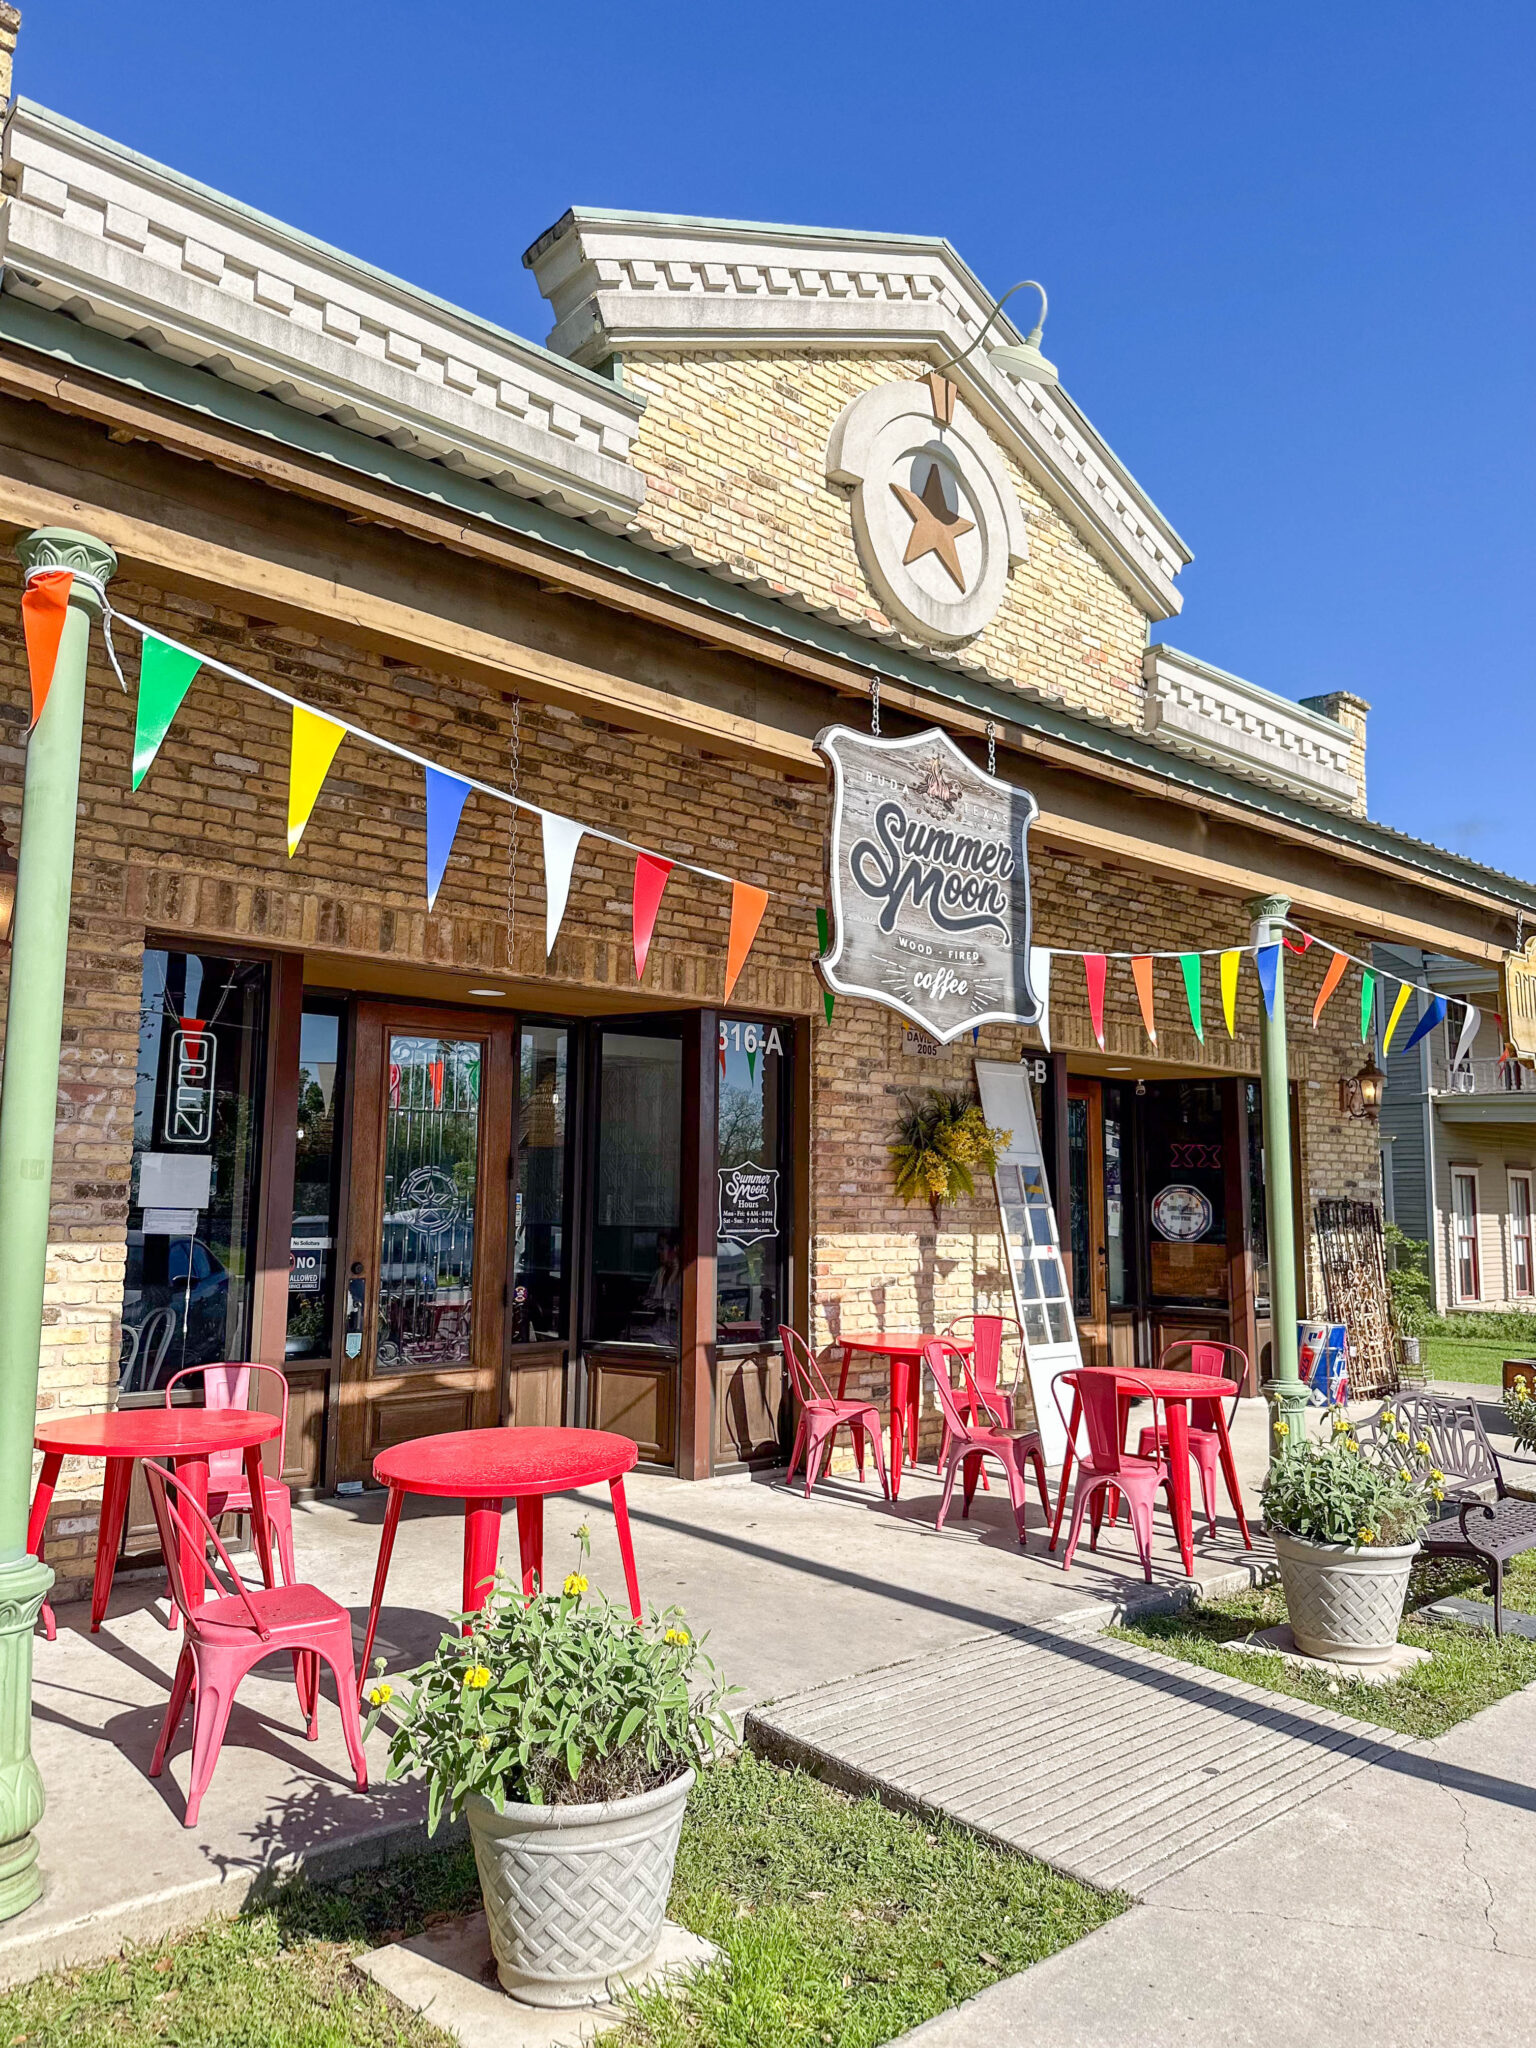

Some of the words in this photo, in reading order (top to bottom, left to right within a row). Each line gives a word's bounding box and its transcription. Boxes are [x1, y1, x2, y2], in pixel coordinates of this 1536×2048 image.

[865, 771, 909, 795] BUDA
[963, 802, 1009, 825] TEXAS
[849, 800, 1015, 901] Summer
[878, 858, 1011, 947] Moon
[898, 936, 932, 955] WOOD
[948, 950, 979, 961] FIRED
[913, 967, 968, 1000] coffee
[917, 1044, 937, 1056] 2005
[174, 1039, 208, 1135] OPEN
[725, 1171, 771, 1196] Summer
[732, 1184, 769, 1203] Moon
[738, 1200, 759, 1208] Hours
[296, 1256, 316, 1269] NO
